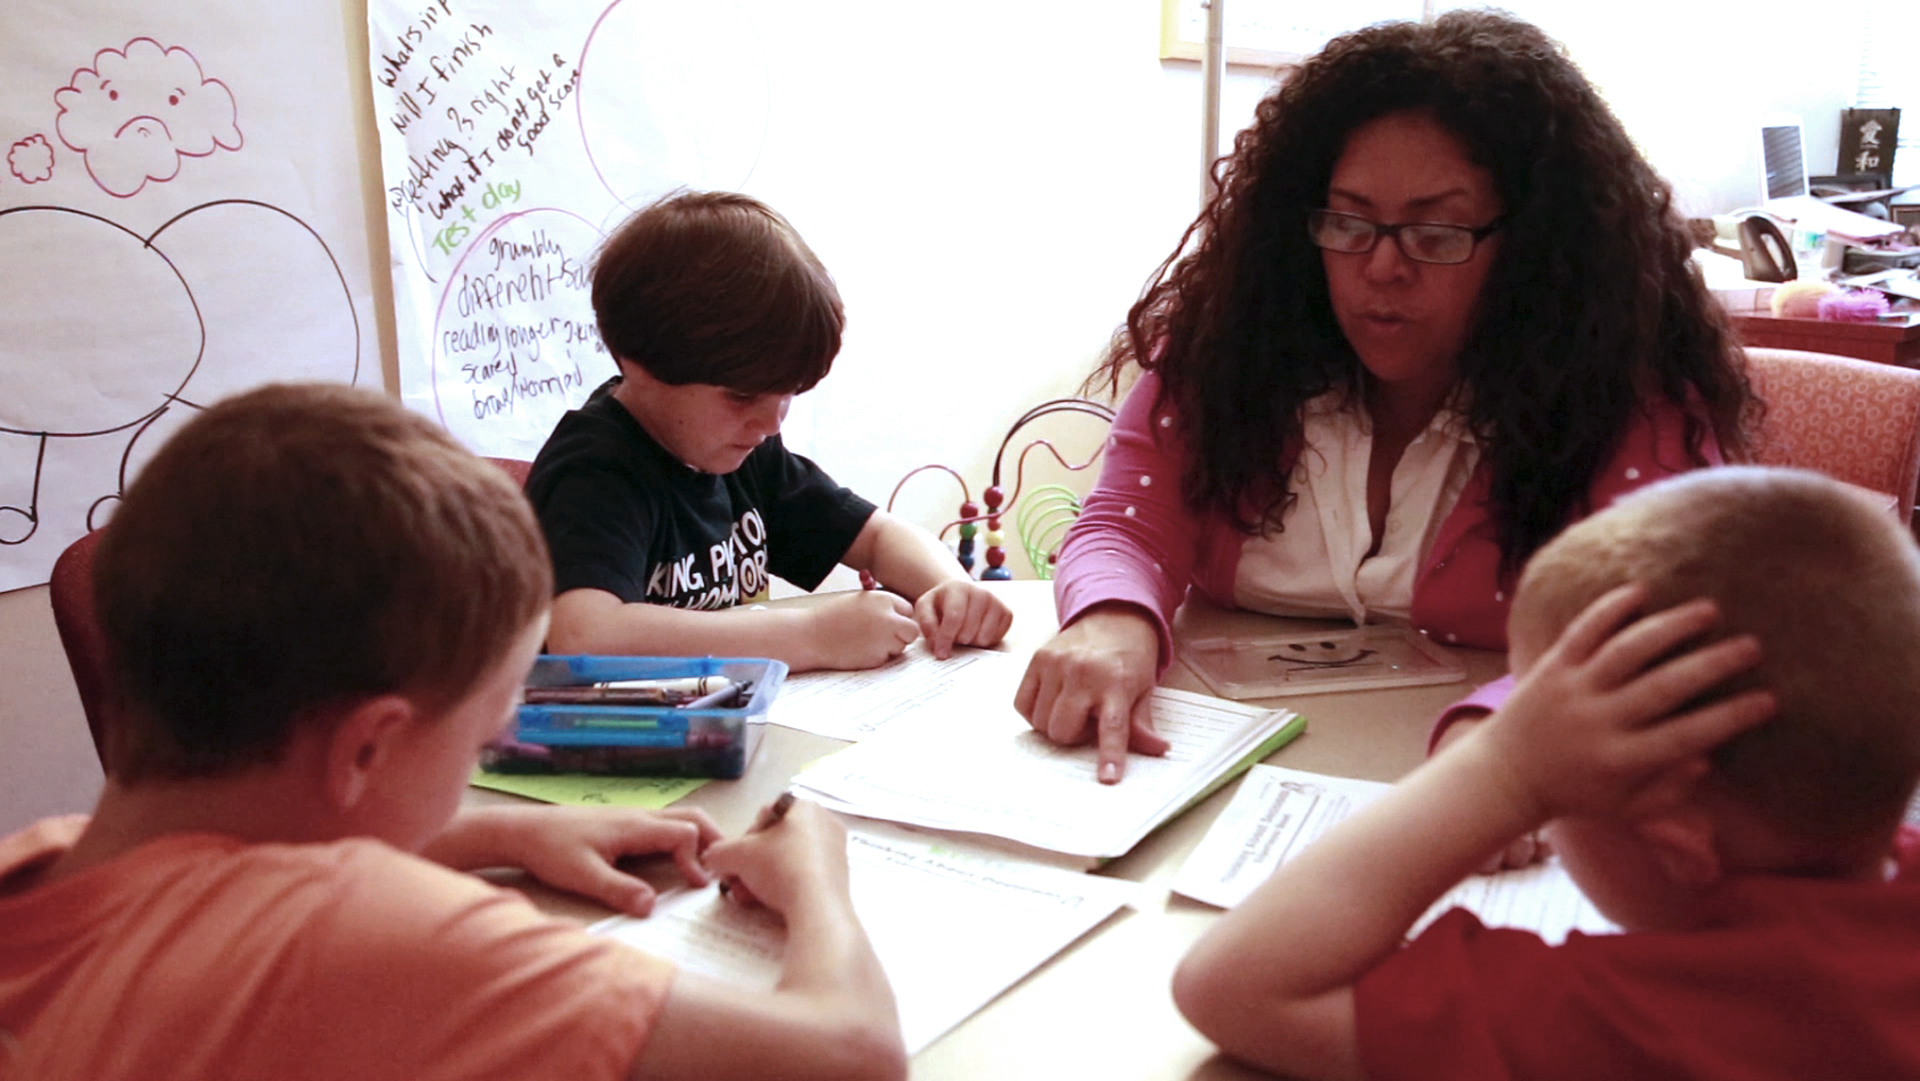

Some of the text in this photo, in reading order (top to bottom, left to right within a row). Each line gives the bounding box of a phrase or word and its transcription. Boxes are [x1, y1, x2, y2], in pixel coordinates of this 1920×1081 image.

[416, 76, 437, 105] I
[429, 23, 493, 82] finish
[552, 53, 567, 69] a
[470, 65, 516, 116] right
[481, 178, 522, 211] day
[488, 229, 565, 272] grumbly
